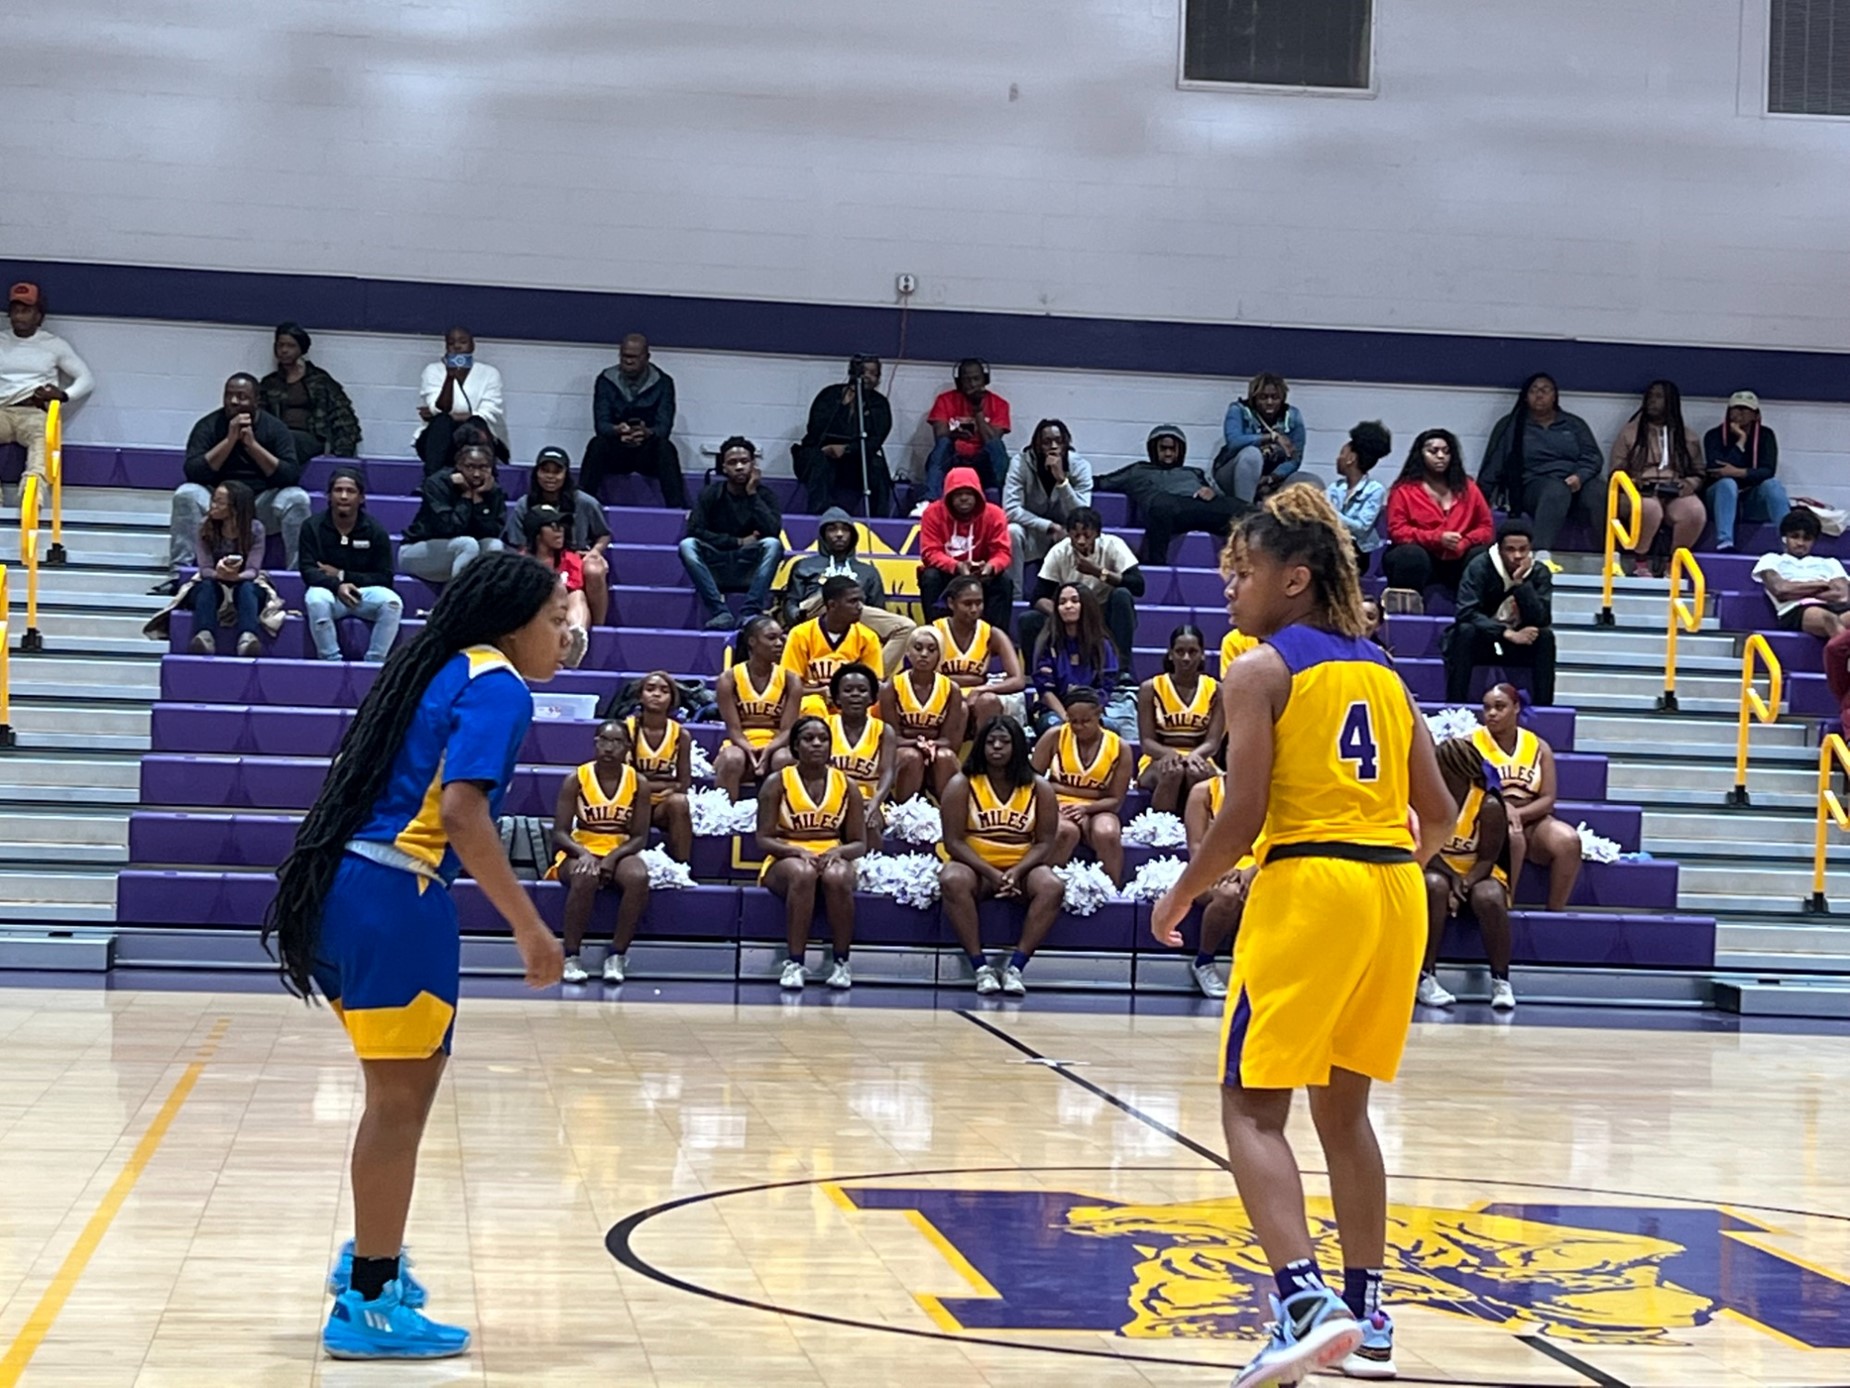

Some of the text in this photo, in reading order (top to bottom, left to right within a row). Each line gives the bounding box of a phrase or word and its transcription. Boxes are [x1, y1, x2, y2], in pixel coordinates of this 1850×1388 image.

[941, 660, 984, 675] MILES
[736, 701, 784, 717] MILES
[900, 712, 944, 727] MILES
[1163, 712, 1210, 728] MILES
[1337, 700, 1379, 782] 4
[1500, 764, 1536, 784] ILES
[584, 804, 633, 822] MILES
[790, 812, 840, 831] MILES
[978, 809, 1029, 830] MILES
